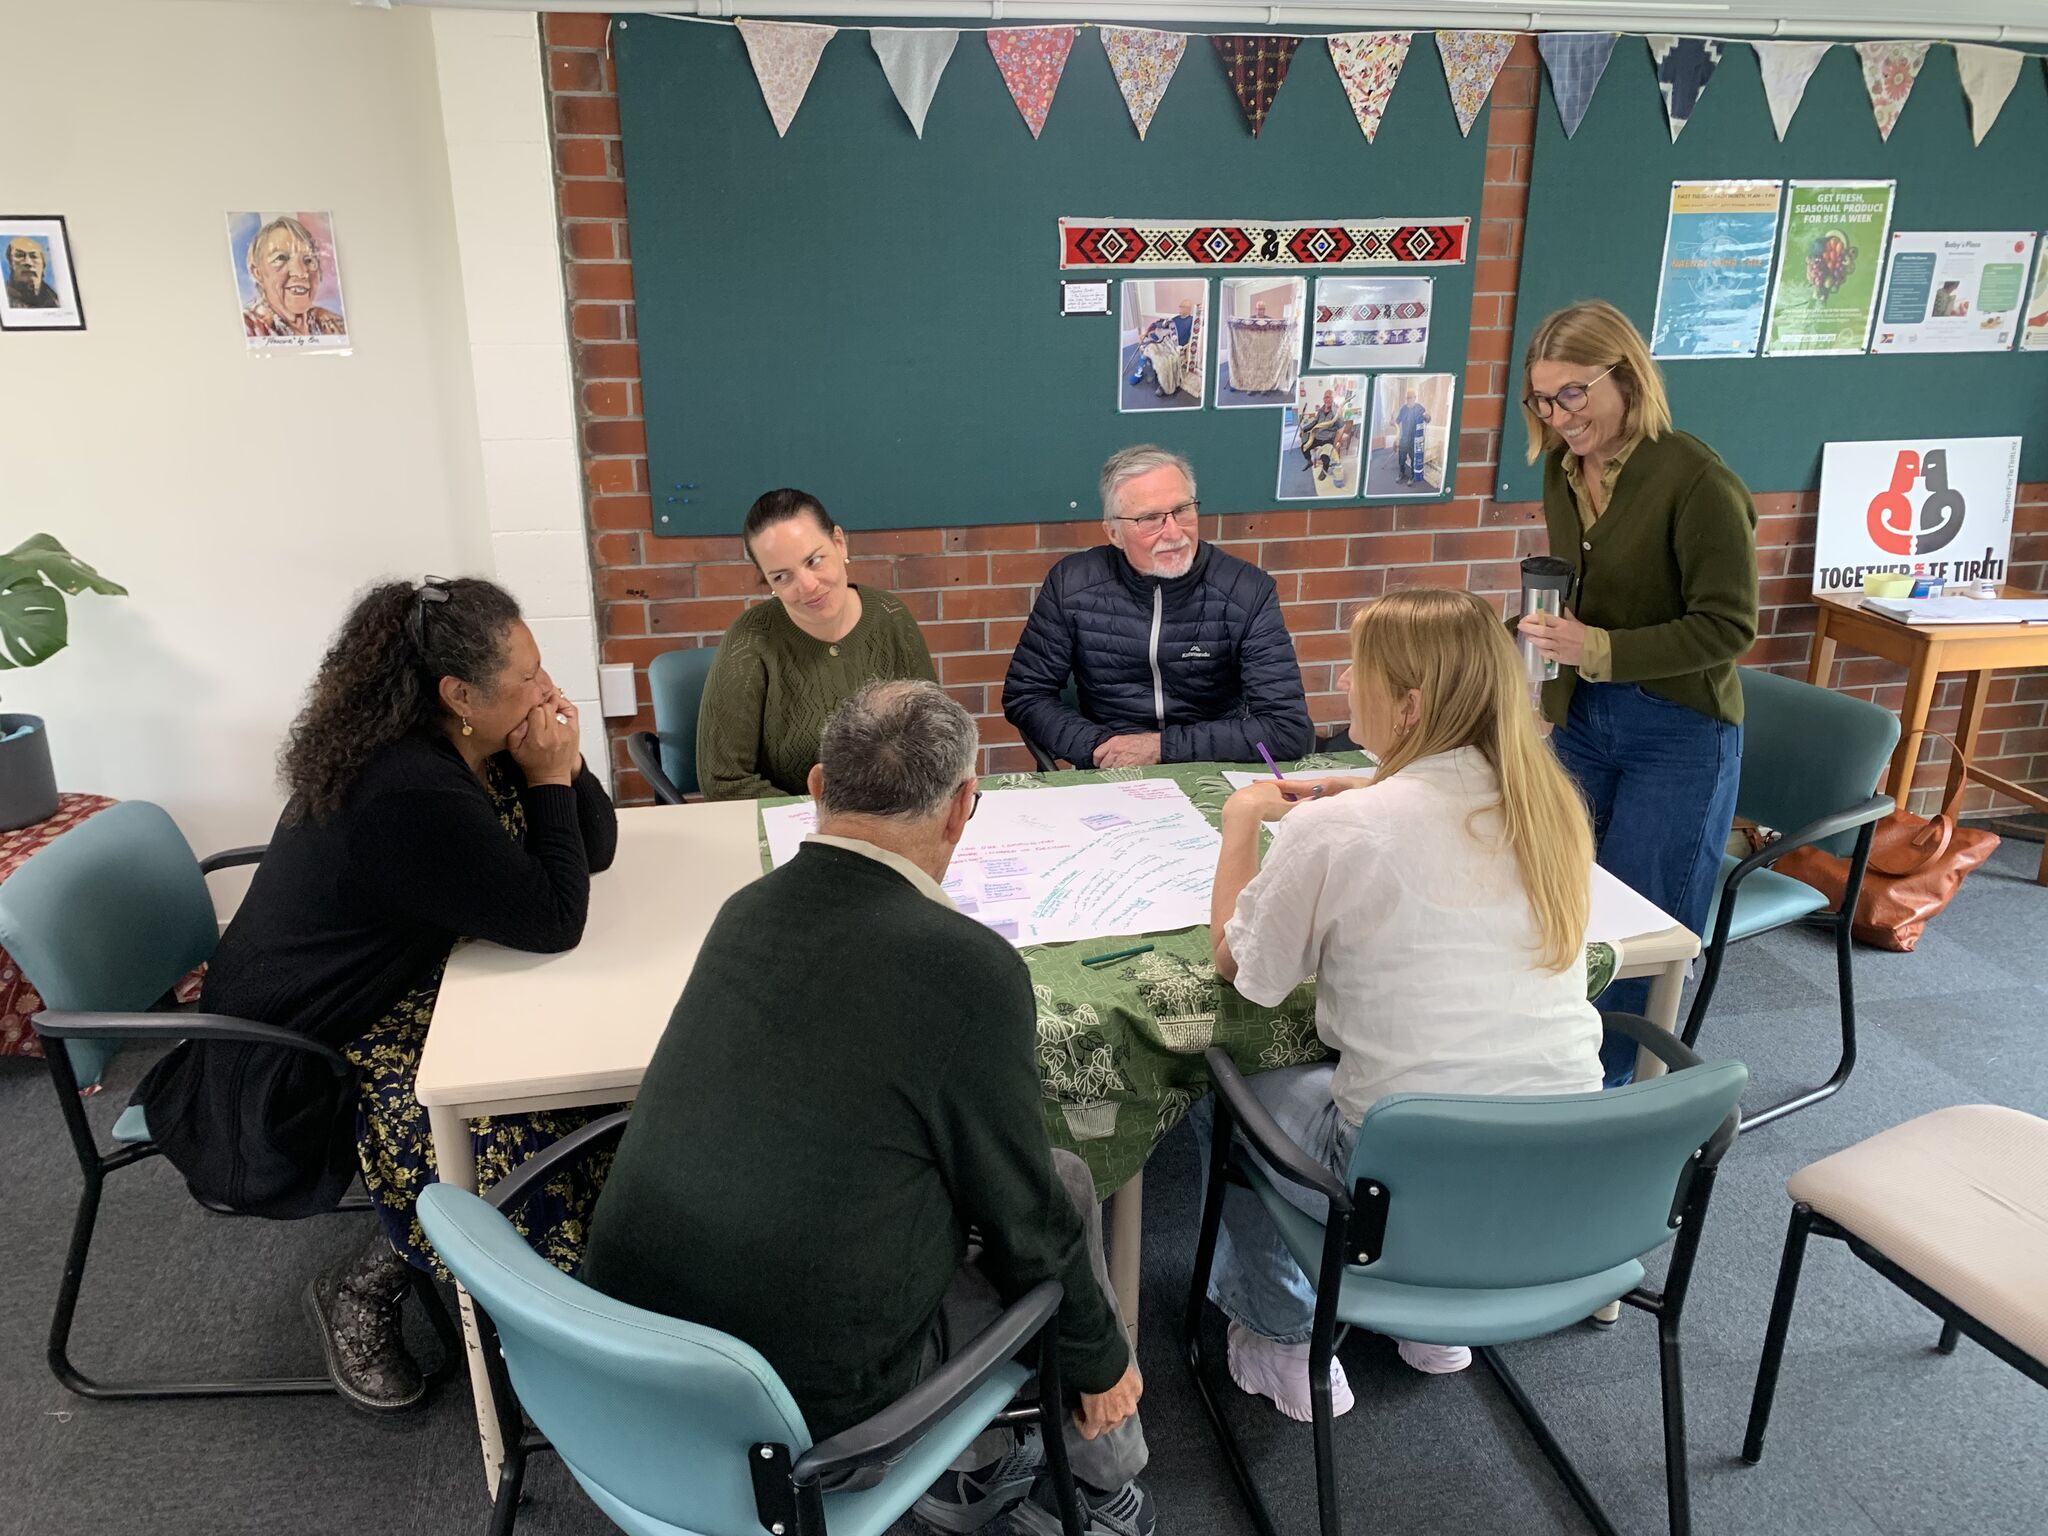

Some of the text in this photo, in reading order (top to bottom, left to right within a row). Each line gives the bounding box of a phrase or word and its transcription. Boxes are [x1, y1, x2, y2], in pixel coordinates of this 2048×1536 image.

[1817, 193, 1864, 203] GET FRESH,
[1795, 203, 1884, 213] SEASONAL PRODUCE
[1803, 214, 1873, 224] FOR $15 A WEEK
